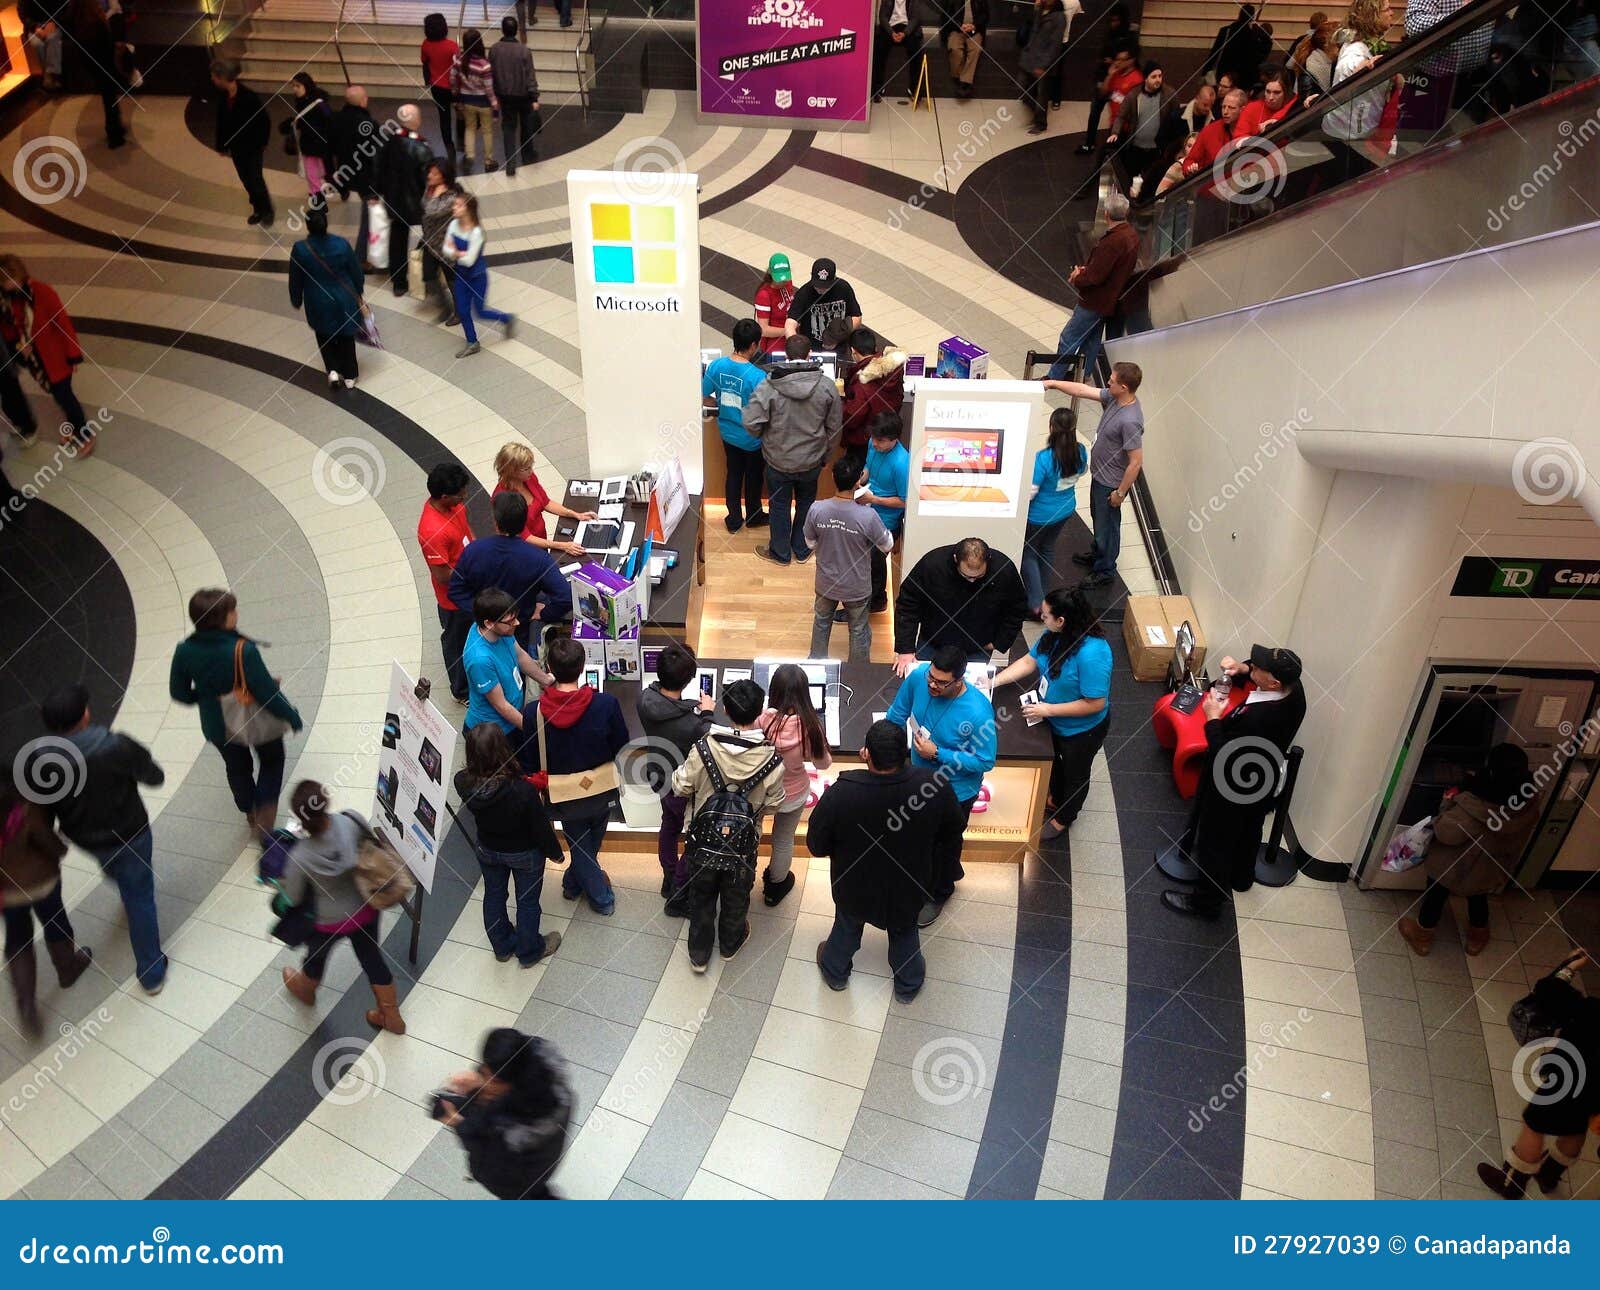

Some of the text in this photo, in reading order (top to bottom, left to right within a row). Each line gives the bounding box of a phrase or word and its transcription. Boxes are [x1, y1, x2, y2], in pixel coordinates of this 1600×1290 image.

[764, 0, 805, 17] toy
[748, 12, 823, 29] mountain
[722, 37, 852, 72] ONE SMILE AT A TIME
[807, 97, 837, 108] CTV
[596, 295, 680, 313] Microsoft
[1500, 567, 1600, 588] TD Can
